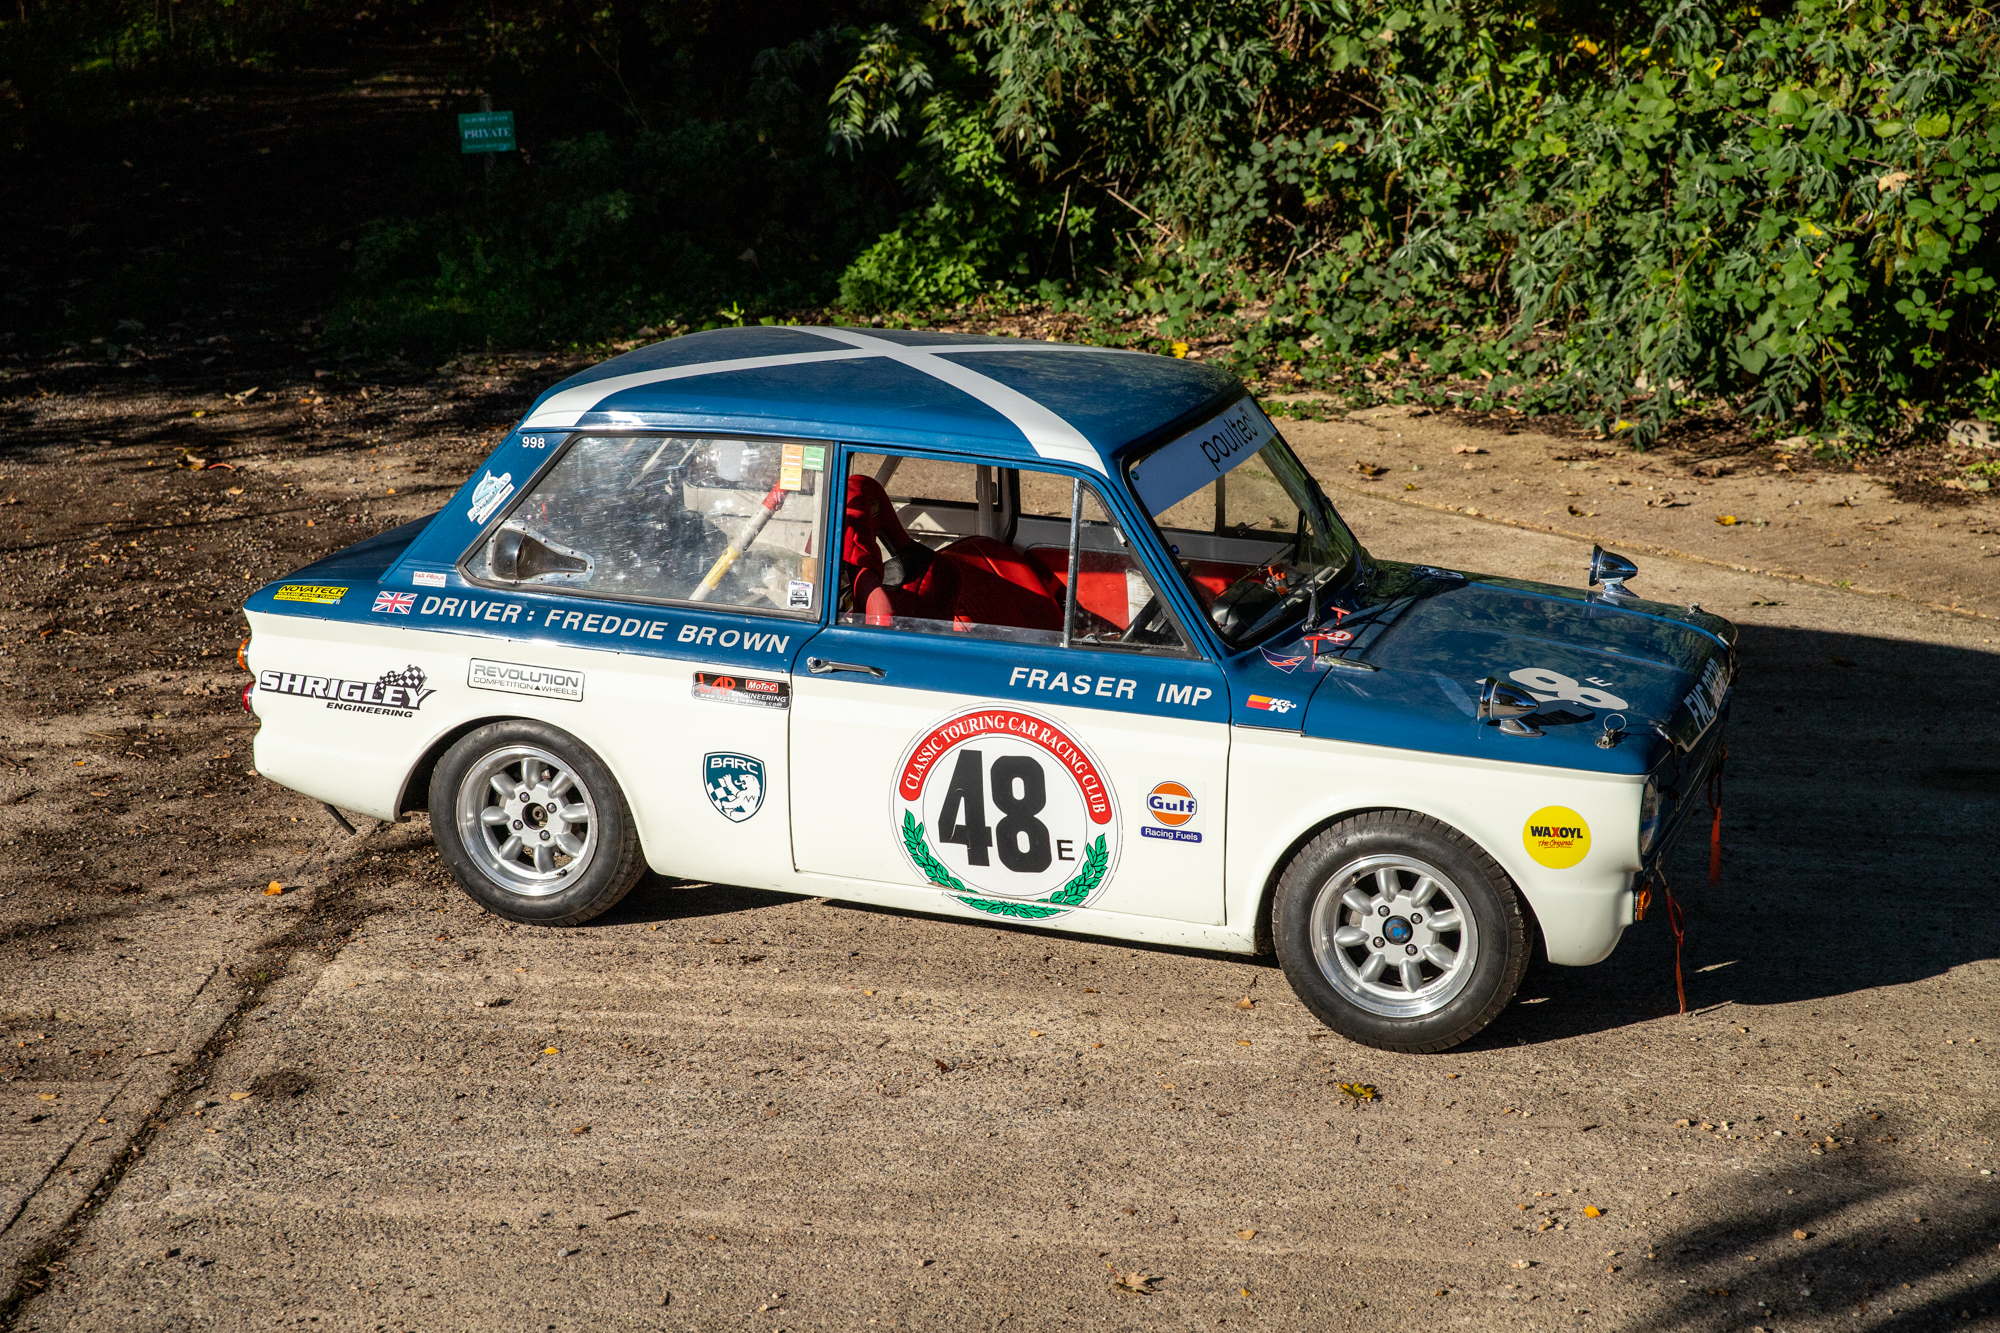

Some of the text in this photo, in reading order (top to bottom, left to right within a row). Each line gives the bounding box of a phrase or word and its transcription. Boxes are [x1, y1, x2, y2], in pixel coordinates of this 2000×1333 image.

[464, 127, 511, 139] PRIVATE
[522, 436, 546, 449] 998
[280, 585, 347, 595] NOVATECH
[544, 609, 669, 640] FREDDIE
[677, 624, 790, 654] BROWN
[474, 664, 579, 688] REVOLUTION
[698, 673, 736, 695] LAP
[1585, 676, 1613, 687] E
[260, 669, 437, 710] SHRIGLEY
[473, 676, 578, 696] COMPETITION WHEELS
[747, 681, 777, 691] MoTeC
[1009, 666, 1212, 706] FRASER IMP
[731, 691, 787, 703] ENGINEERING
[326, 702, 414, 718] ENGINEERING
[1268, 698, 1297, 714] K&N
[1683, 683, 1715, 732] FMC
[711, 757, 759, 775] BARC
[905, 715, 1106, 814] CLASSIC TOURING CAR RACING CLUB
[938, 748, 1075, 873] 48 E
[1149, 795, 1195, 812] Gulf
[1145, 827, 1198, 841] Racing Fuels
[1530, 826, 1583, 839] WAXOYL
[1549, 839, 1575, 848] Original
